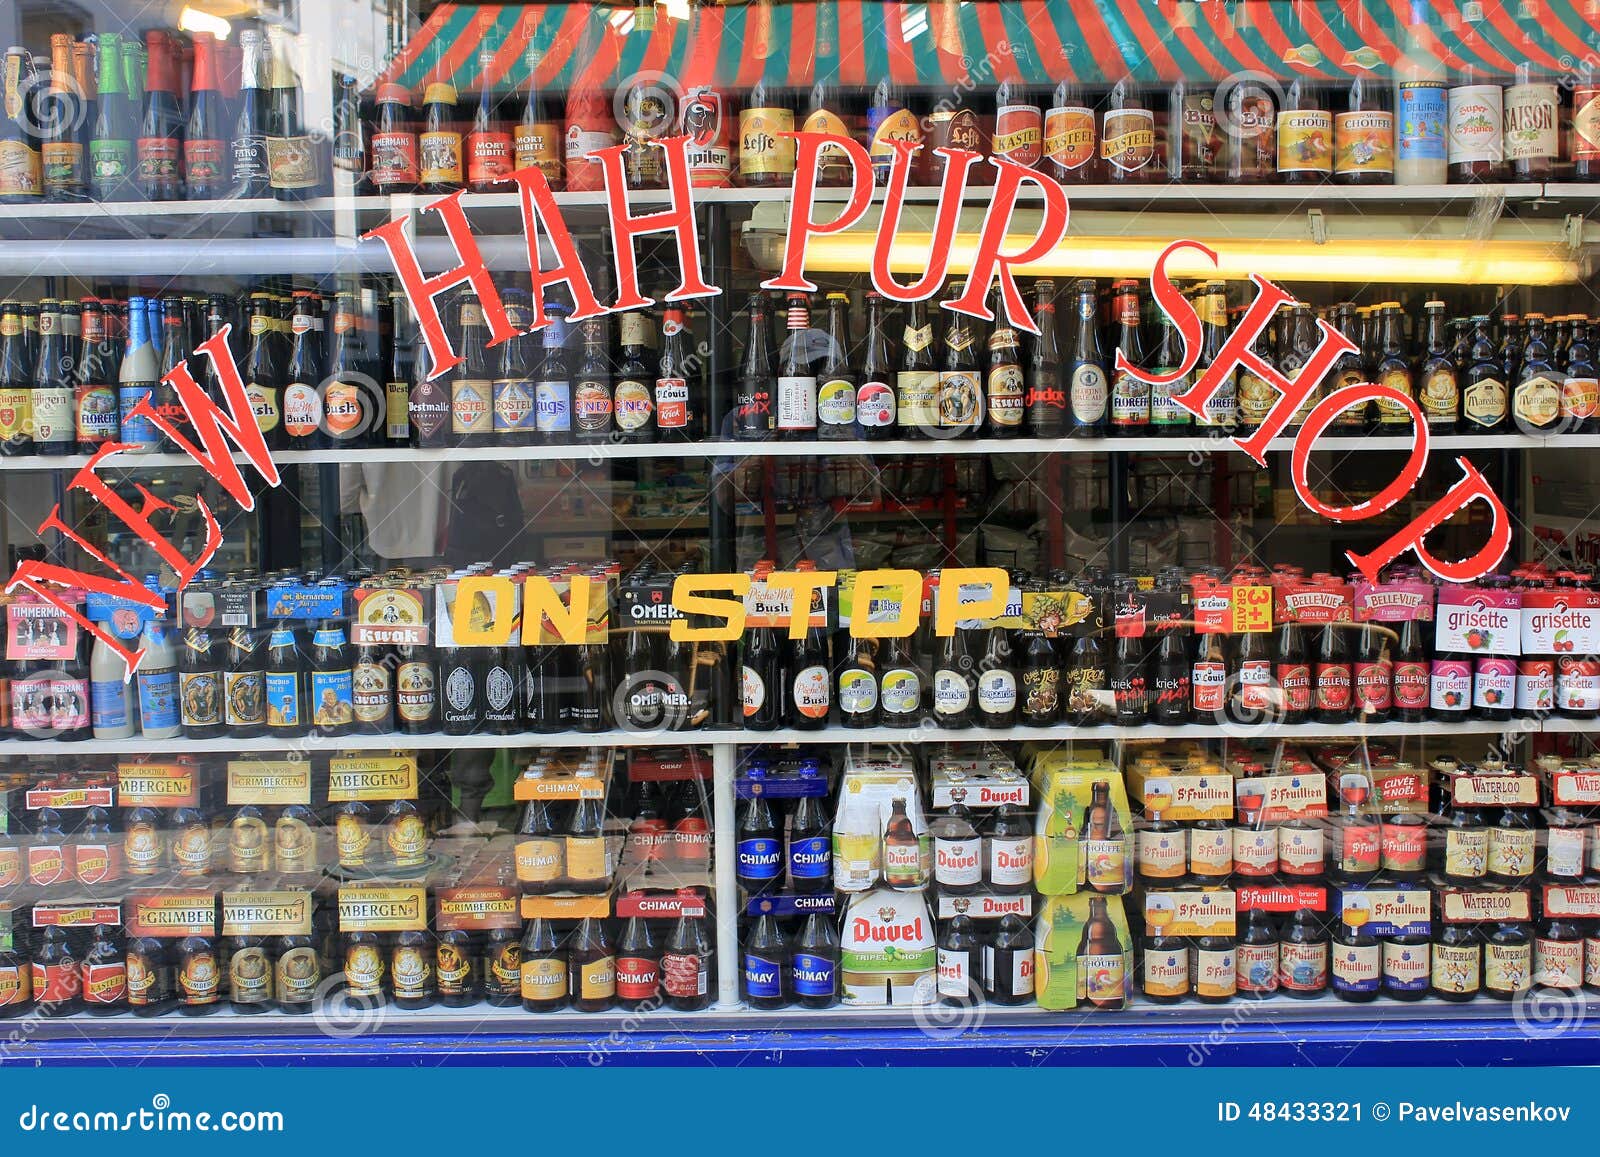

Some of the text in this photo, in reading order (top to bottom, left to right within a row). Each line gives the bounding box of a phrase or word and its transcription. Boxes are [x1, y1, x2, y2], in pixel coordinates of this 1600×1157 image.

[1503, 104, 1553, 132] SAISON
[516, 135, 543, 143] MORT
[743, 133, 776, 151] Leffe
[1045, 130, 1094, 152] KASTEEL
[1104, 132, 1153, 155] KASTEEL
[476, 142, 505, 150] MORT
[4, 131, 1513, 684] NEW HAH PUR SHOP
[325, 402, 357, 414] Bush
[496, 401, 532, 410] POSTEL
[287, 414, 313, 424] Bush
[295, 593, 335, 601] Bernardus
[1207, 599, 1227, 607] Louis
[453, 567, 1009, 645] ON STOP
[756, 603, 790, 612] Bush
[1237, 588, 1247, 631] GRATIS
[1248, 589, 1270, 631] 3+1
[1448, 609, 1509, 631] grisette
[1531, 611, 1592, 633] grisette
[1111, 678, 1132, 689] kriek
[1156, 678, 1179, 689] kriek
[1203, 673, 1224, 682] Louis
[1478, 678, 1511, 689] grisette
[1436, 680, 1469, 690] grisette
[803, 696, 827, 704] Bush
[1385, 776, 1415, 787] CUVÉE
[1472, 779, 1520, 793] WATERLOO
[537, 783, 581, 793] CHIMAY
[1187, 786, 1229, 802] Feuillien
[1390, 785, 1416, 797] NOËL
[980, 788, 1023, 803] Duvel
[518, 855, 560, 866] CHIMAY
[740, 852, 781, 865] CHIMAY
[887, 852, 918, 864] Duvel
[938, 850, 979, 869] Duvel
[1251, 890, 1295, 906] Feuillien
[1462, 893, 1511, 909] WATERLOO
[447, 901, 511, 912] GRIMBERGEN
[639, 901, 682, 911] CHIMAY
[983, 898, 1025, 913] Duvel
[1189, 903, 1232, 918] Feuillien
[1384, 903, 1426, 917] Feuillien
[853, 917, 924, 943] Duvel
[1537, 941, 1579, 956] WATERLOO
[524, 973, 564, 985] CHIMAY
[616, 972, 655, 984] CHIMAY
